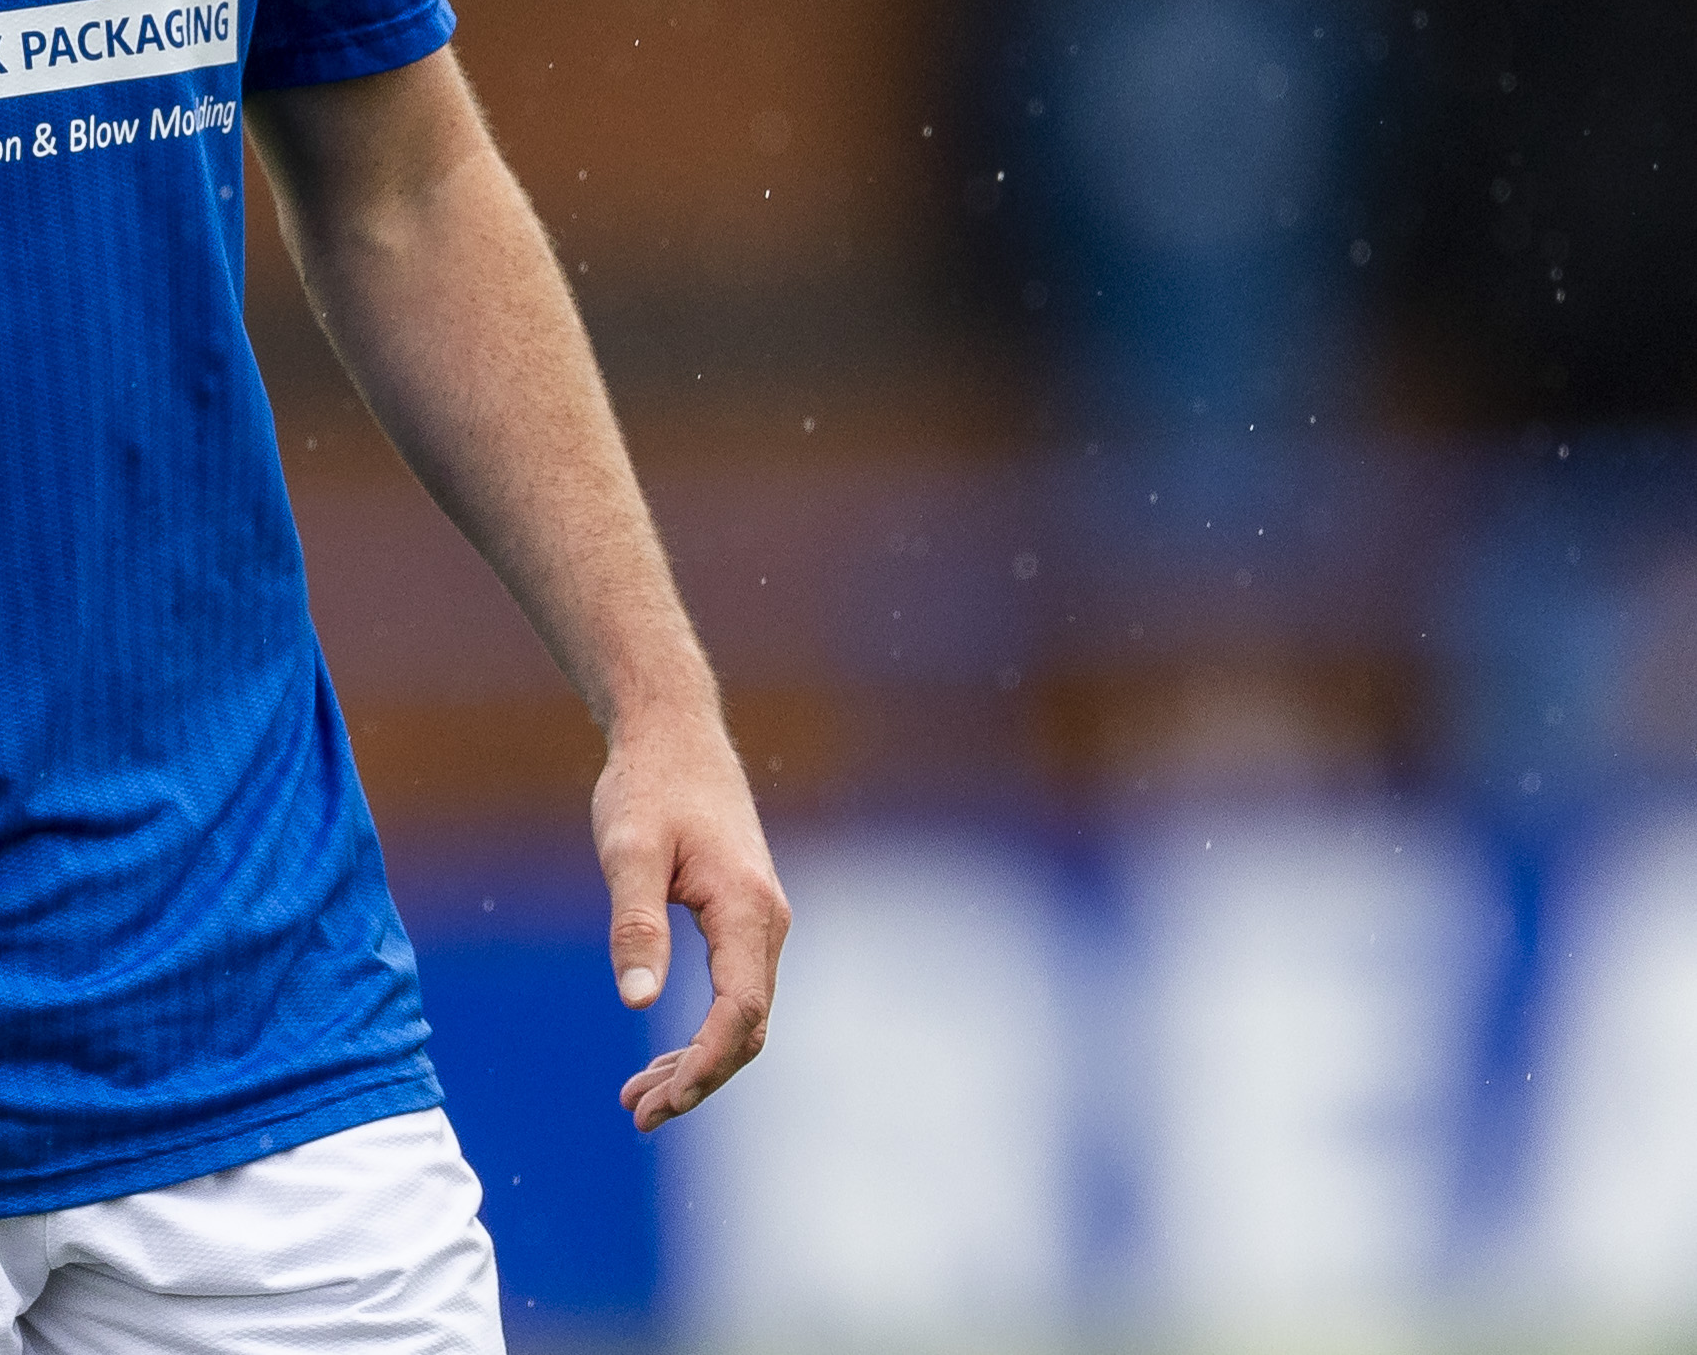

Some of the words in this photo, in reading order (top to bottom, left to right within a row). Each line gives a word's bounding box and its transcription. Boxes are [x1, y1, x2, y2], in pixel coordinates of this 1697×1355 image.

[21, 1, 229, 70] PACKAGING
[32, 122, 58, 158] &
[69, 114, 140, 153] Blow
